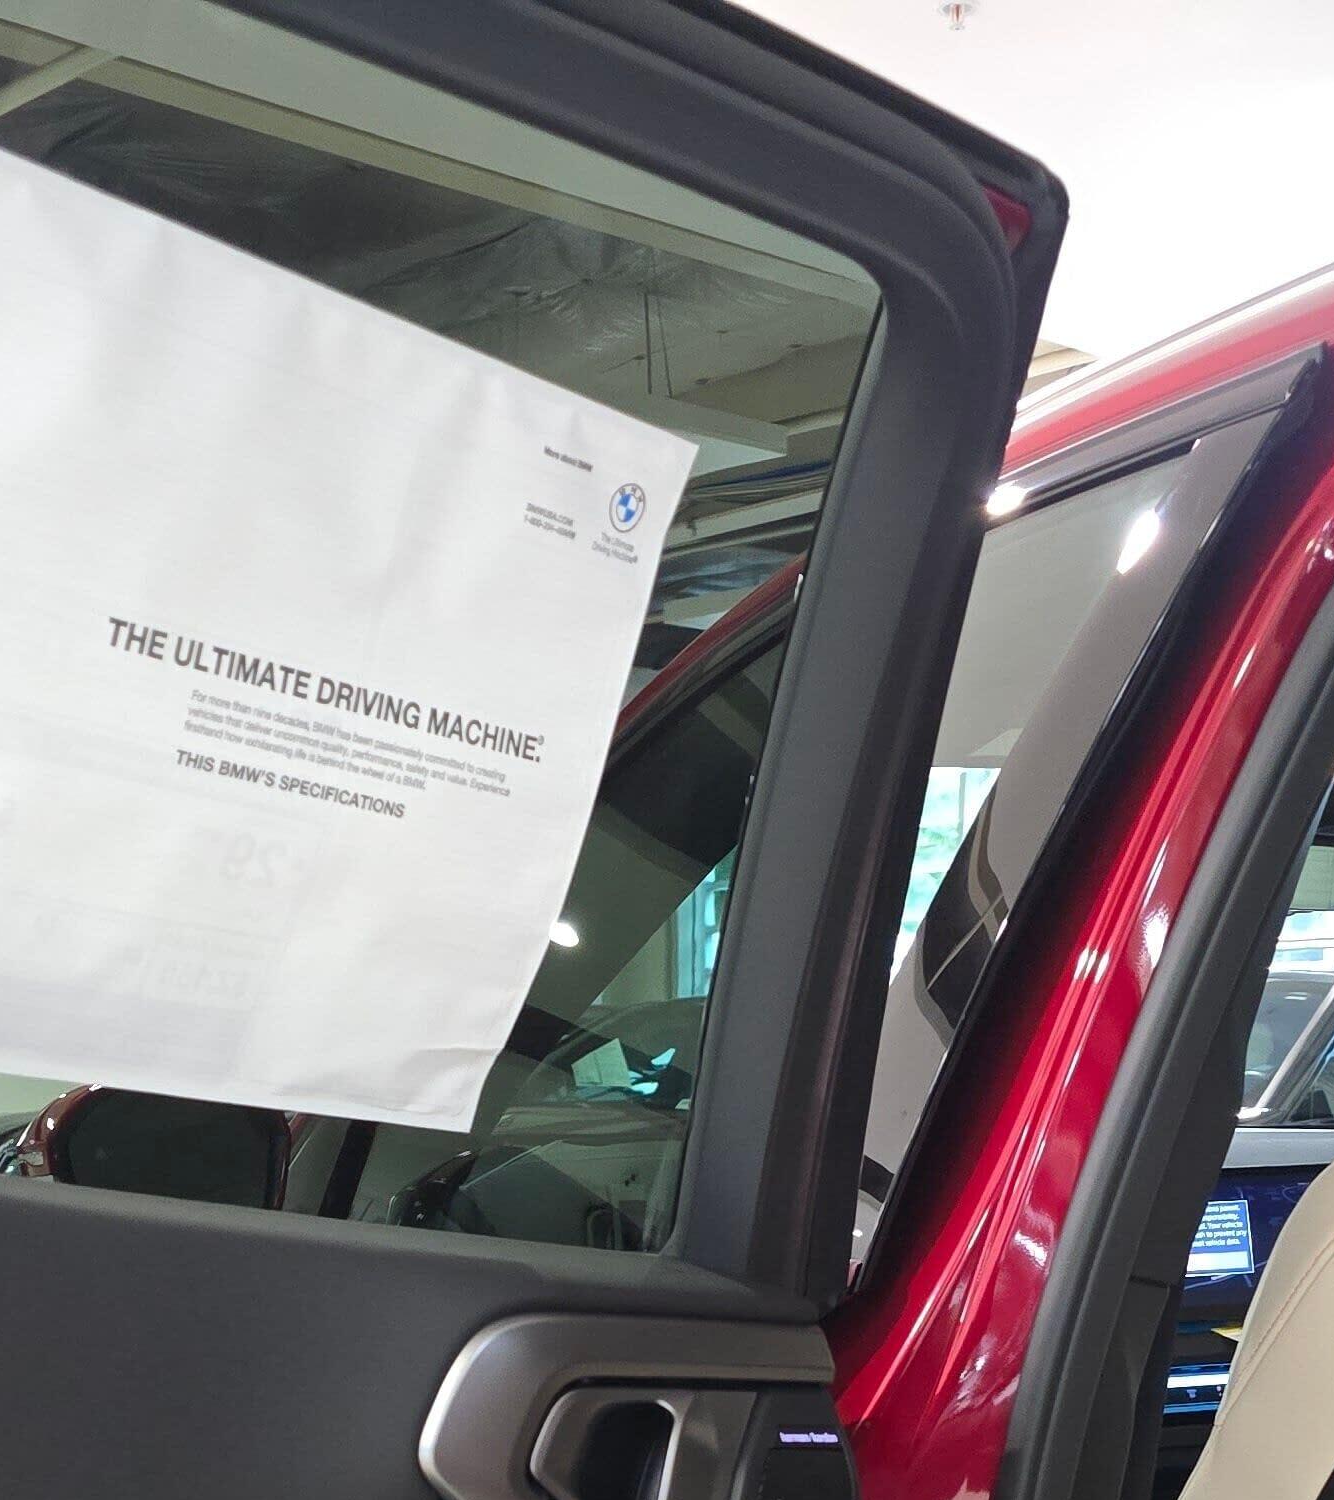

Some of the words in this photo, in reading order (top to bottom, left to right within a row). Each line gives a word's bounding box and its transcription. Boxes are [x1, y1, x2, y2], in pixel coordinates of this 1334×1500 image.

[109, 616, 168, 660] THE
[174, 636, 312, 699] ULTIMATE
[316, 676, 421, 729] DRIVING
[177, 749, 215, 772] THIS
[218, 760, 276, 787] BMW'S
[278, 773, 405, 818] SPECIFICATIONS
